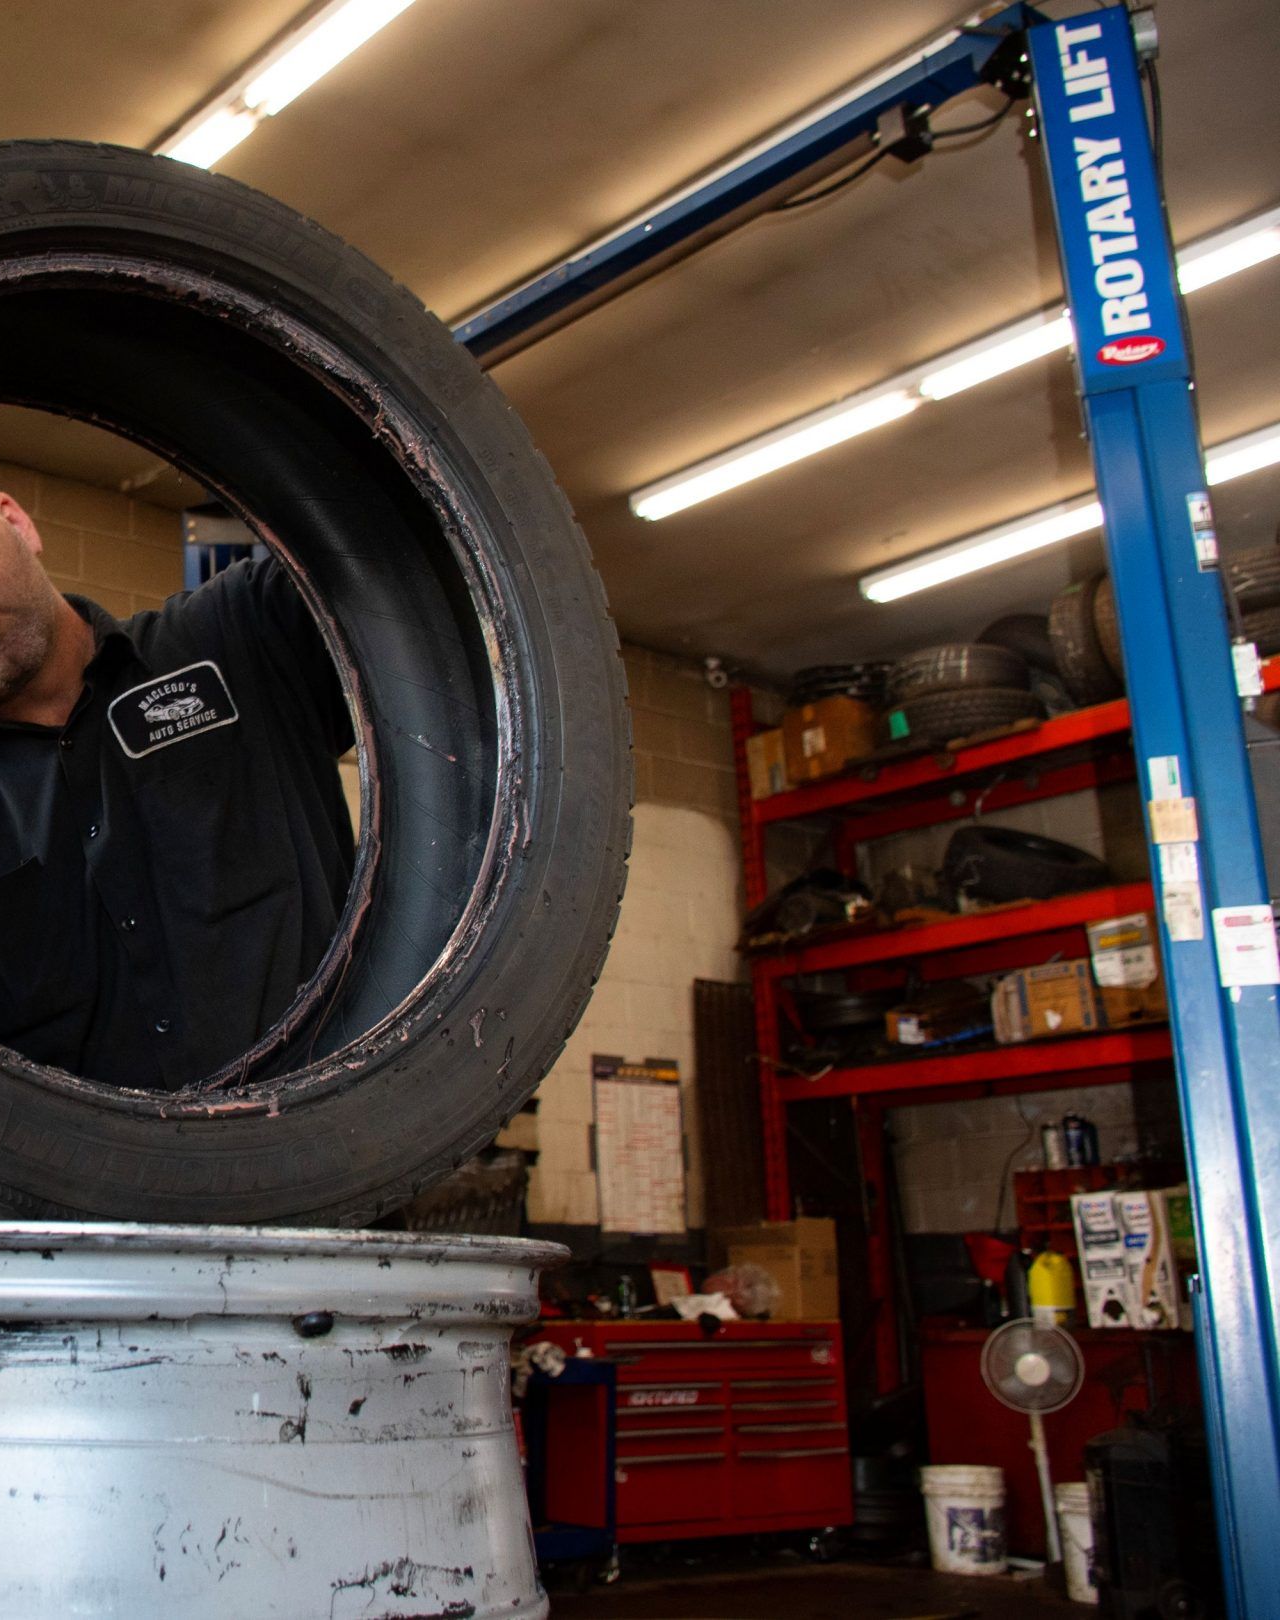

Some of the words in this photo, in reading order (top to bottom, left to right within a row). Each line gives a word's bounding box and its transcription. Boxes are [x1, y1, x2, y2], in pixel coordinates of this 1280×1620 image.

[1055, 22, 1116, 124] LIFT
[103, 175, 338, 276] MICHELIN
[1073, 136, 1152, 337] ROTARY
[1102, 341, 1159, 361] Rotary
[138, 682, 198, 711] MACLEOD'S
[149, 724, 175, 742] AUTO
[176, 708, 218, 732] SERVICE
